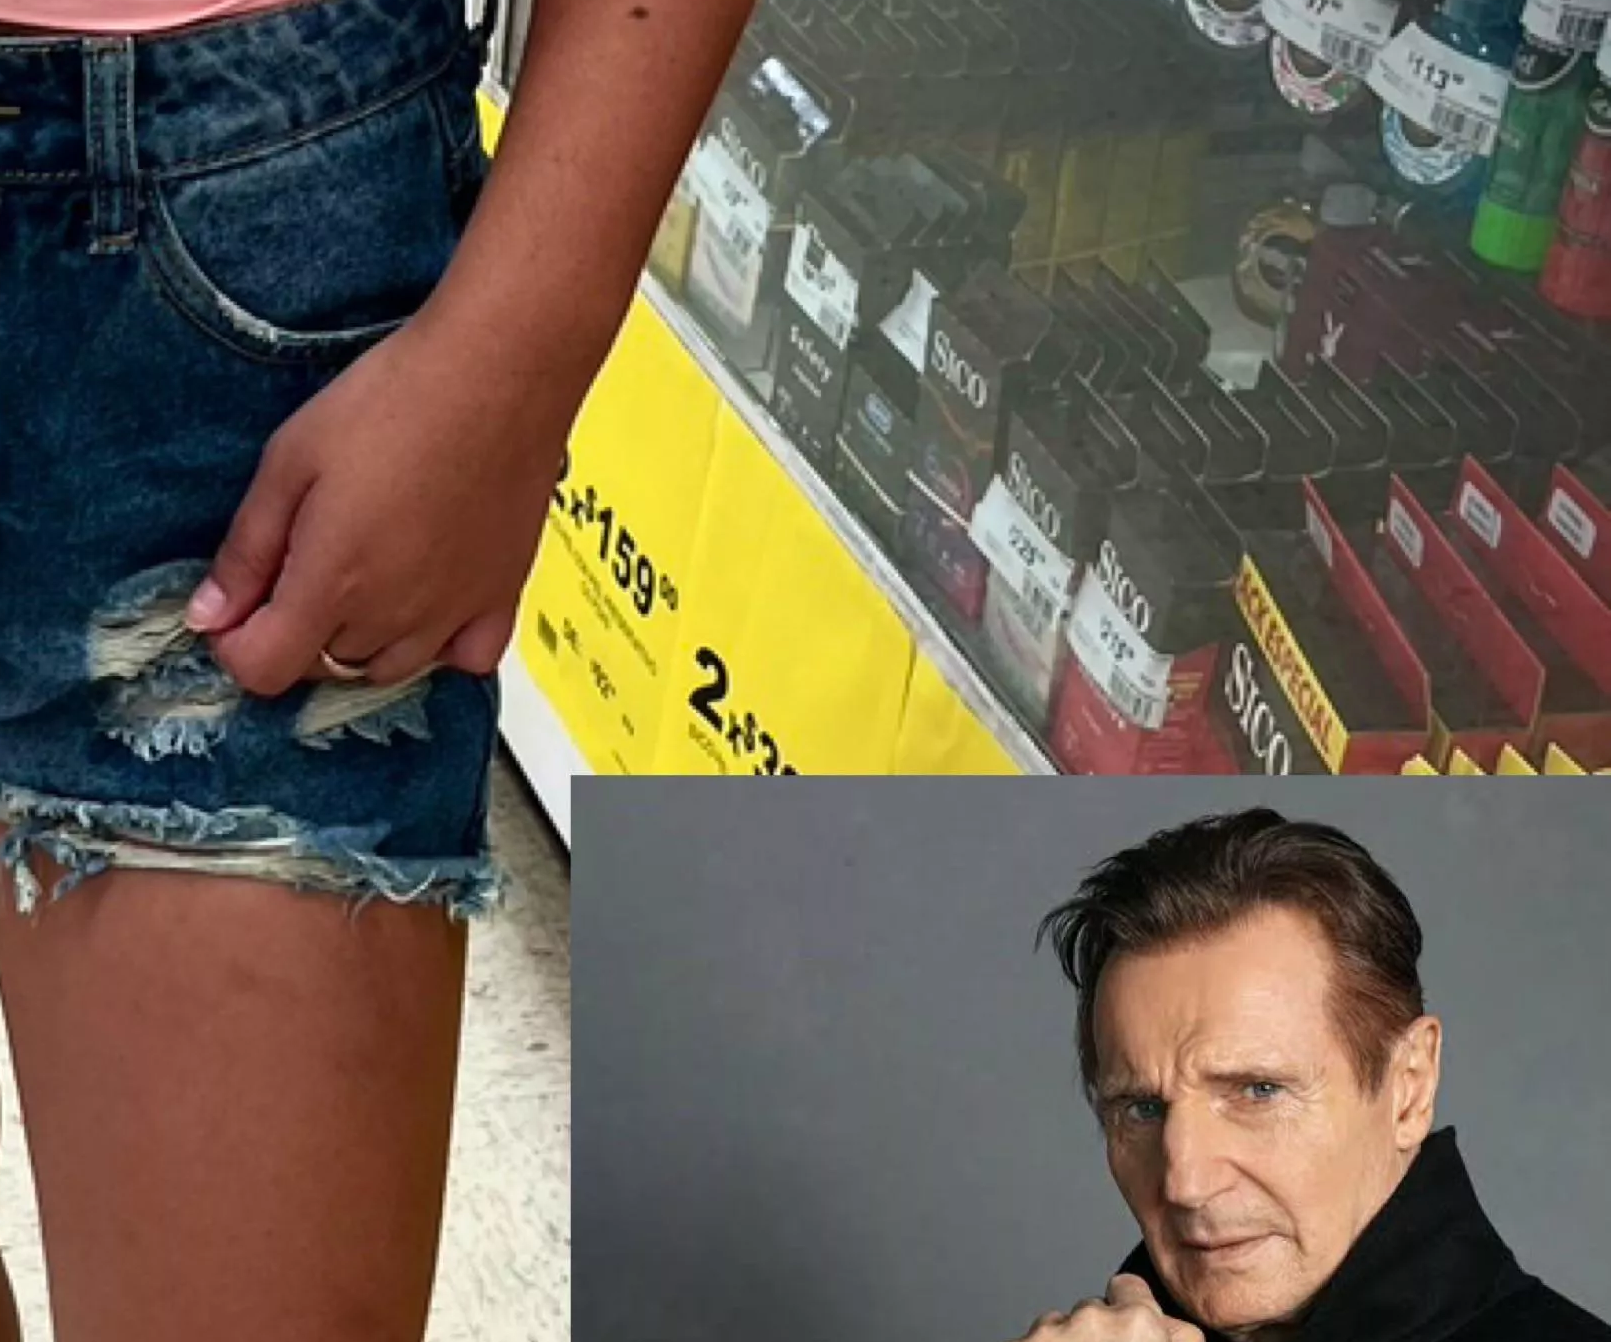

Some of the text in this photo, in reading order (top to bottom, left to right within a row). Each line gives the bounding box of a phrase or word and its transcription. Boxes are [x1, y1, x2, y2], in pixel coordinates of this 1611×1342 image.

[932, 329, 989, 409] SICO
[1008, 451, 1062, 539] SICO
[1095, 539, 1150, 633] SICO
[1225, 642, 1292, 775] SICO
